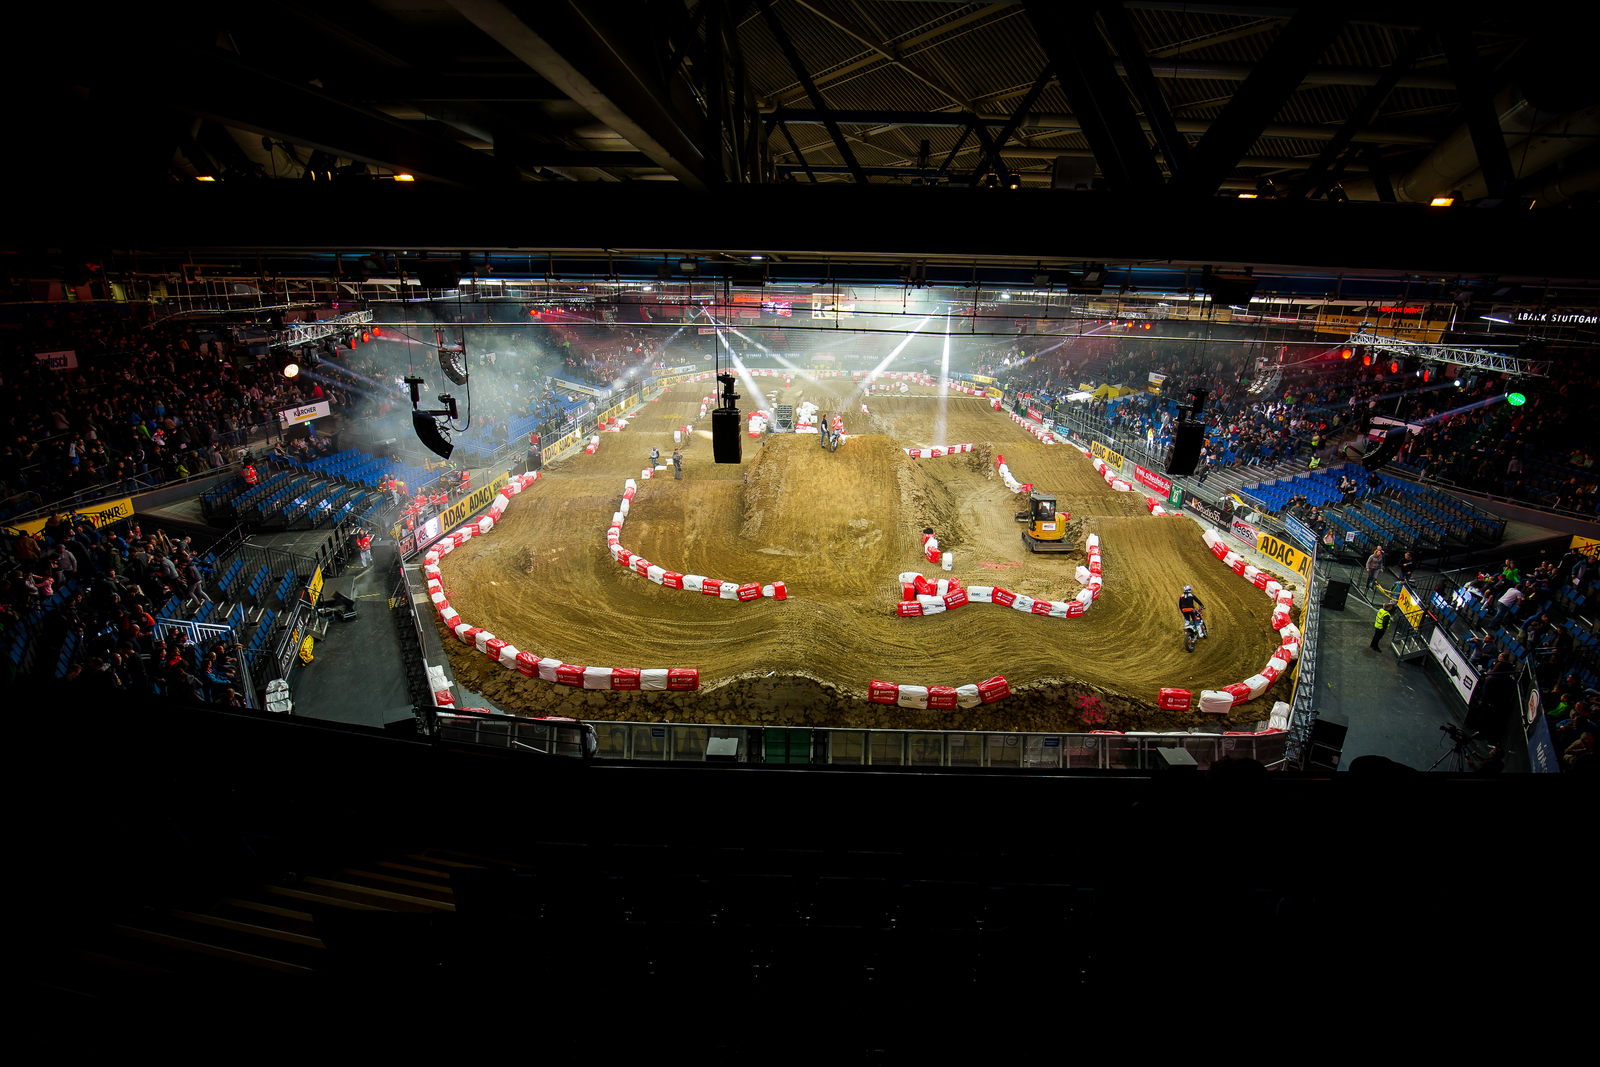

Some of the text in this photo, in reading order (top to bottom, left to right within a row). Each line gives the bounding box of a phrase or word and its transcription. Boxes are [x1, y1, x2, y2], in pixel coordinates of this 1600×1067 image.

[469, 487, 489, 513] ADAC
[443, 502, 466, 530] ADAC
[1260, 536, 1294, 567] ADAC
